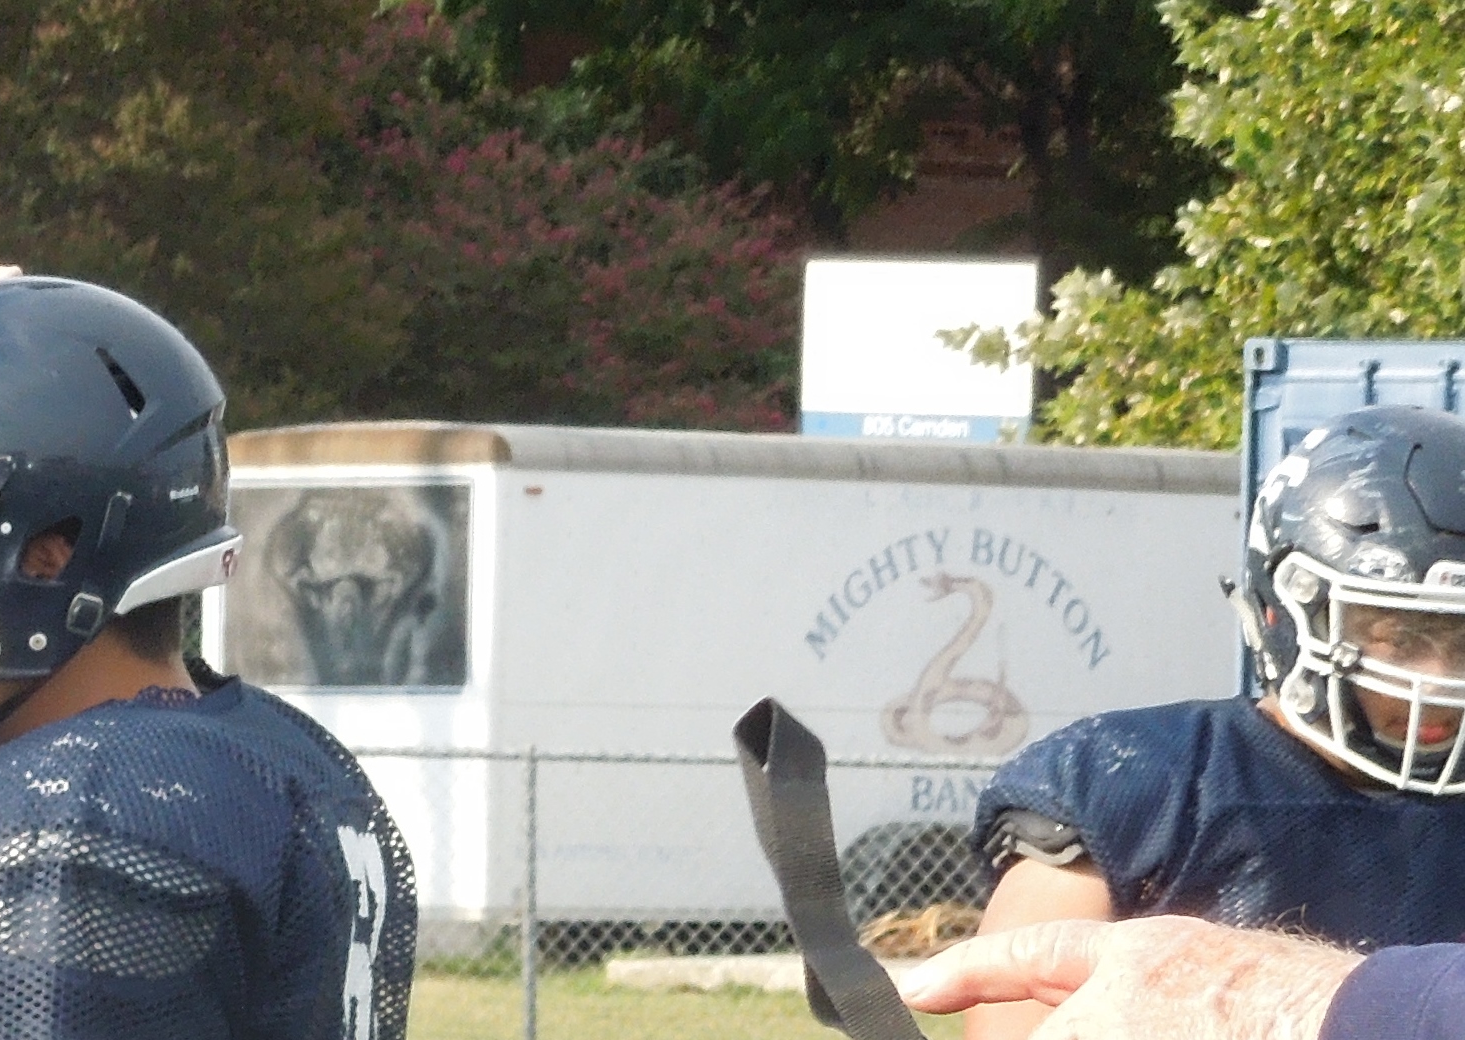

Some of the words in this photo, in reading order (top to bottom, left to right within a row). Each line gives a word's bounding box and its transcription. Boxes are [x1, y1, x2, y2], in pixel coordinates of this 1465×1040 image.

[898, 415, 969, 438] Camden
[804, 527, 950, 660] MIGHTY
[970, 528, 1111, 670] BUTTON
[910, 775, 987, 814] BAN
